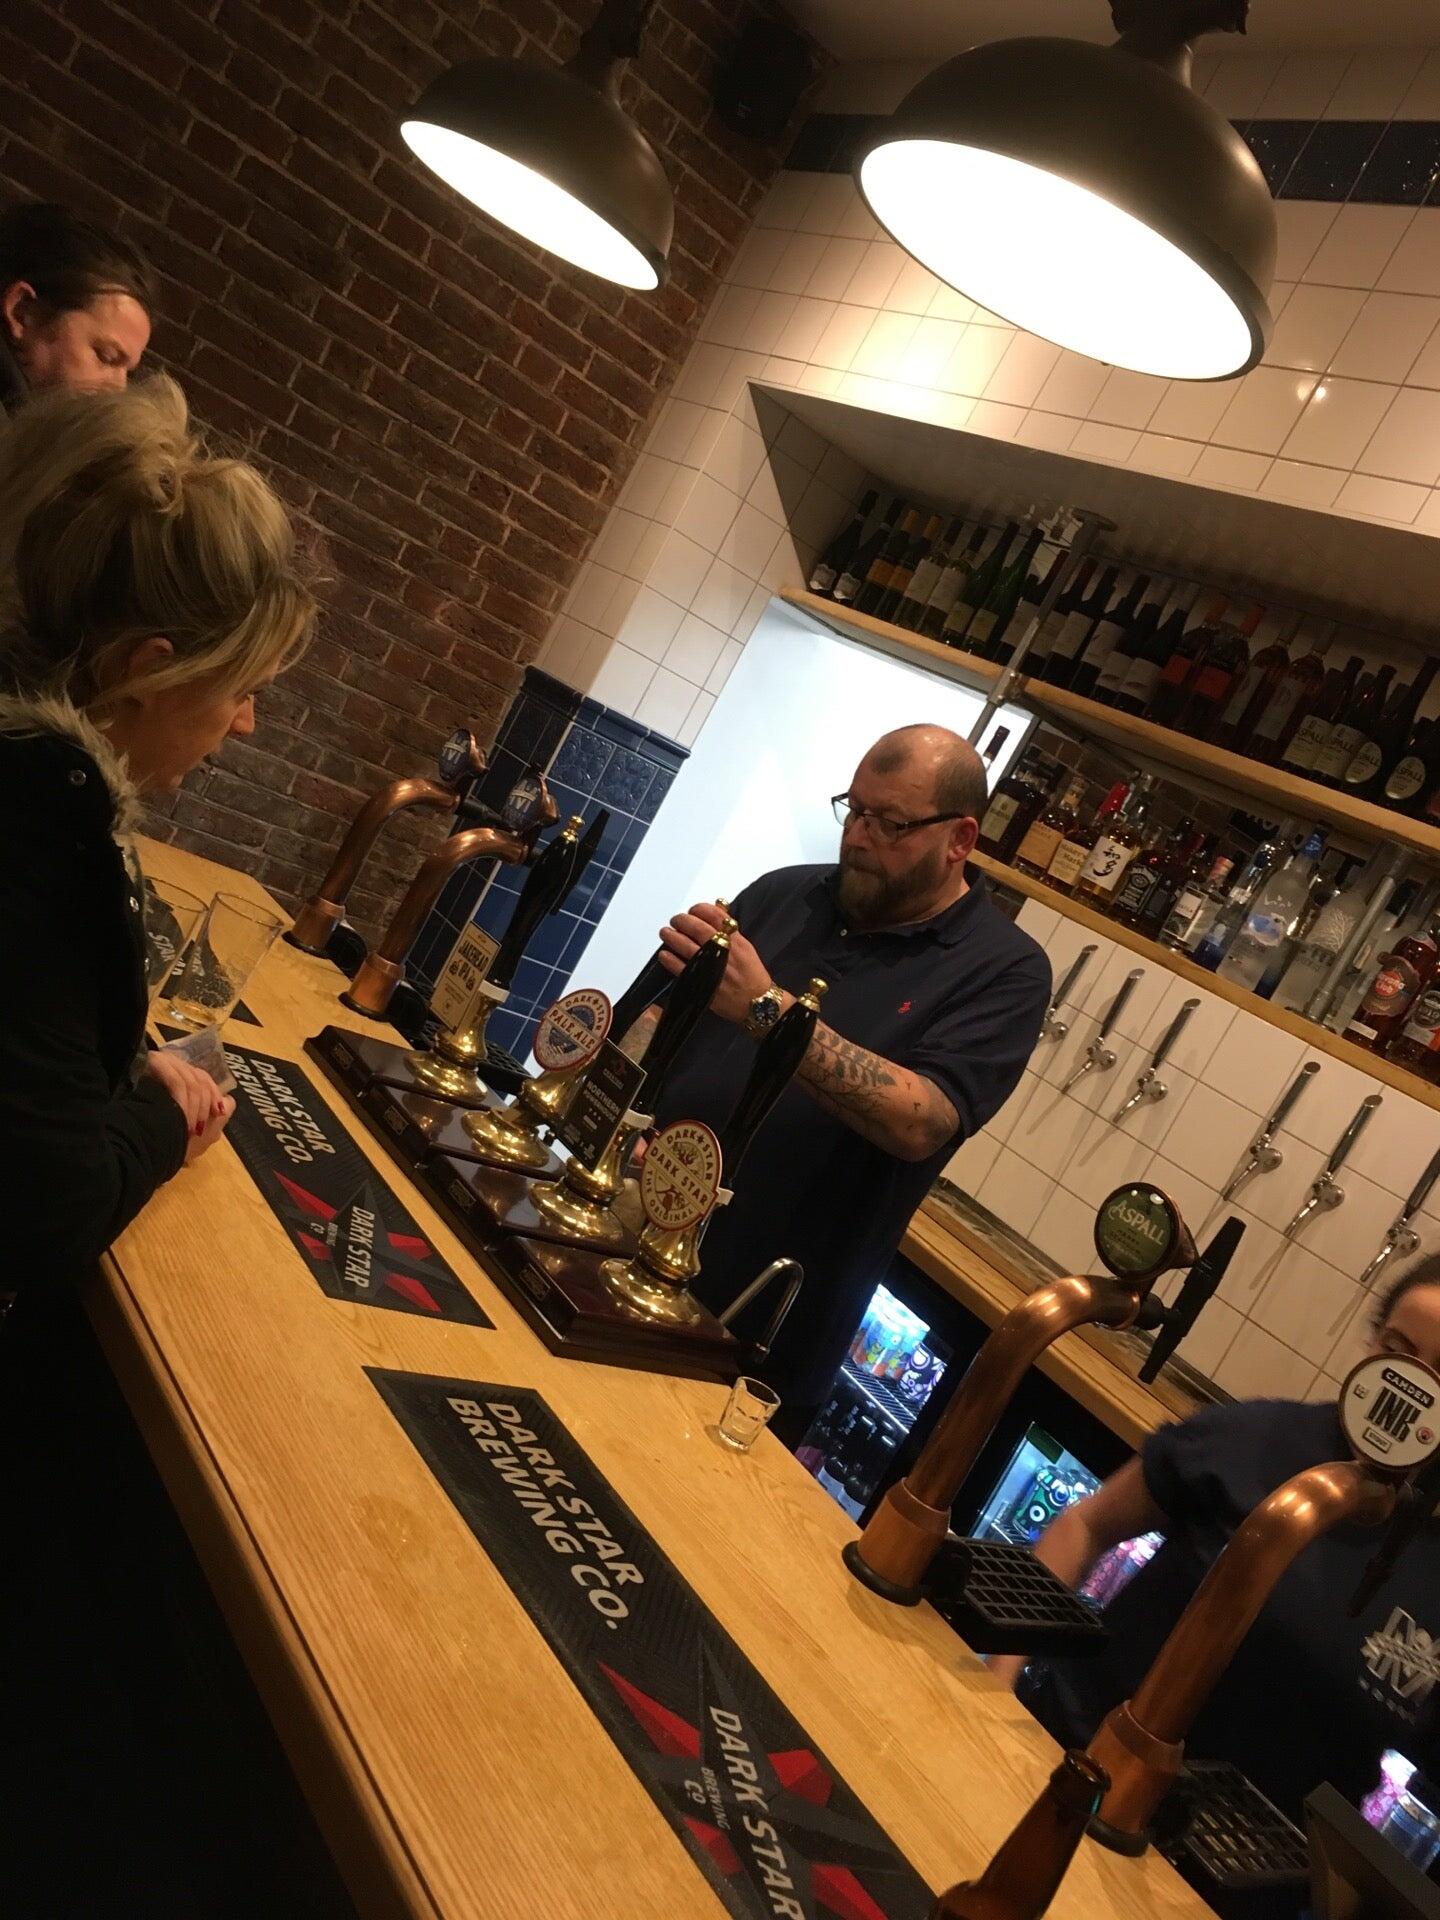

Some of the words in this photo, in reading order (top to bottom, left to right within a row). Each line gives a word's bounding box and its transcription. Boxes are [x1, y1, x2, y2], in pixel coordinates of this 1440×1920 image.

[549, 1009, 575, 1033] PALE
[574, 1030, 596, 1049] ALE
[224, 1051, 293, 1132] BREWING
[276, 1133, 313, 1164] CO.
[250, 1059, 304, 1109] DARK
[283, 1106, 336, 1154] STAR
[586, 1080, 621, 1115] NORTHERN
[650, 1147, 679, 1178] DARK
[681, 1176, 708, 1206] STAR
[349, 1205, 375, 1249] DARK
[650, 1199, 693, 1220] ORIGINAL
[1108, 1200, 1165, 1246] ASPALL
[344, 1244, 372, 1288] STAR
[1366, 1386, 1422, 1444] INK
[1385, 1371, 1431, 1405] CAMDEN
[446, 1397, 585, 1554] BREWING
[570, 1564, 629, 1630] CO.
[485, 1402, 577, 1491] DARK
[556, 1495, 645, 1586] STAR
[700, 1766, 731, 1831] BREWING
[709, 1706, 769, 1816] DARK
[742, 1815, 806, 1920] STAR
